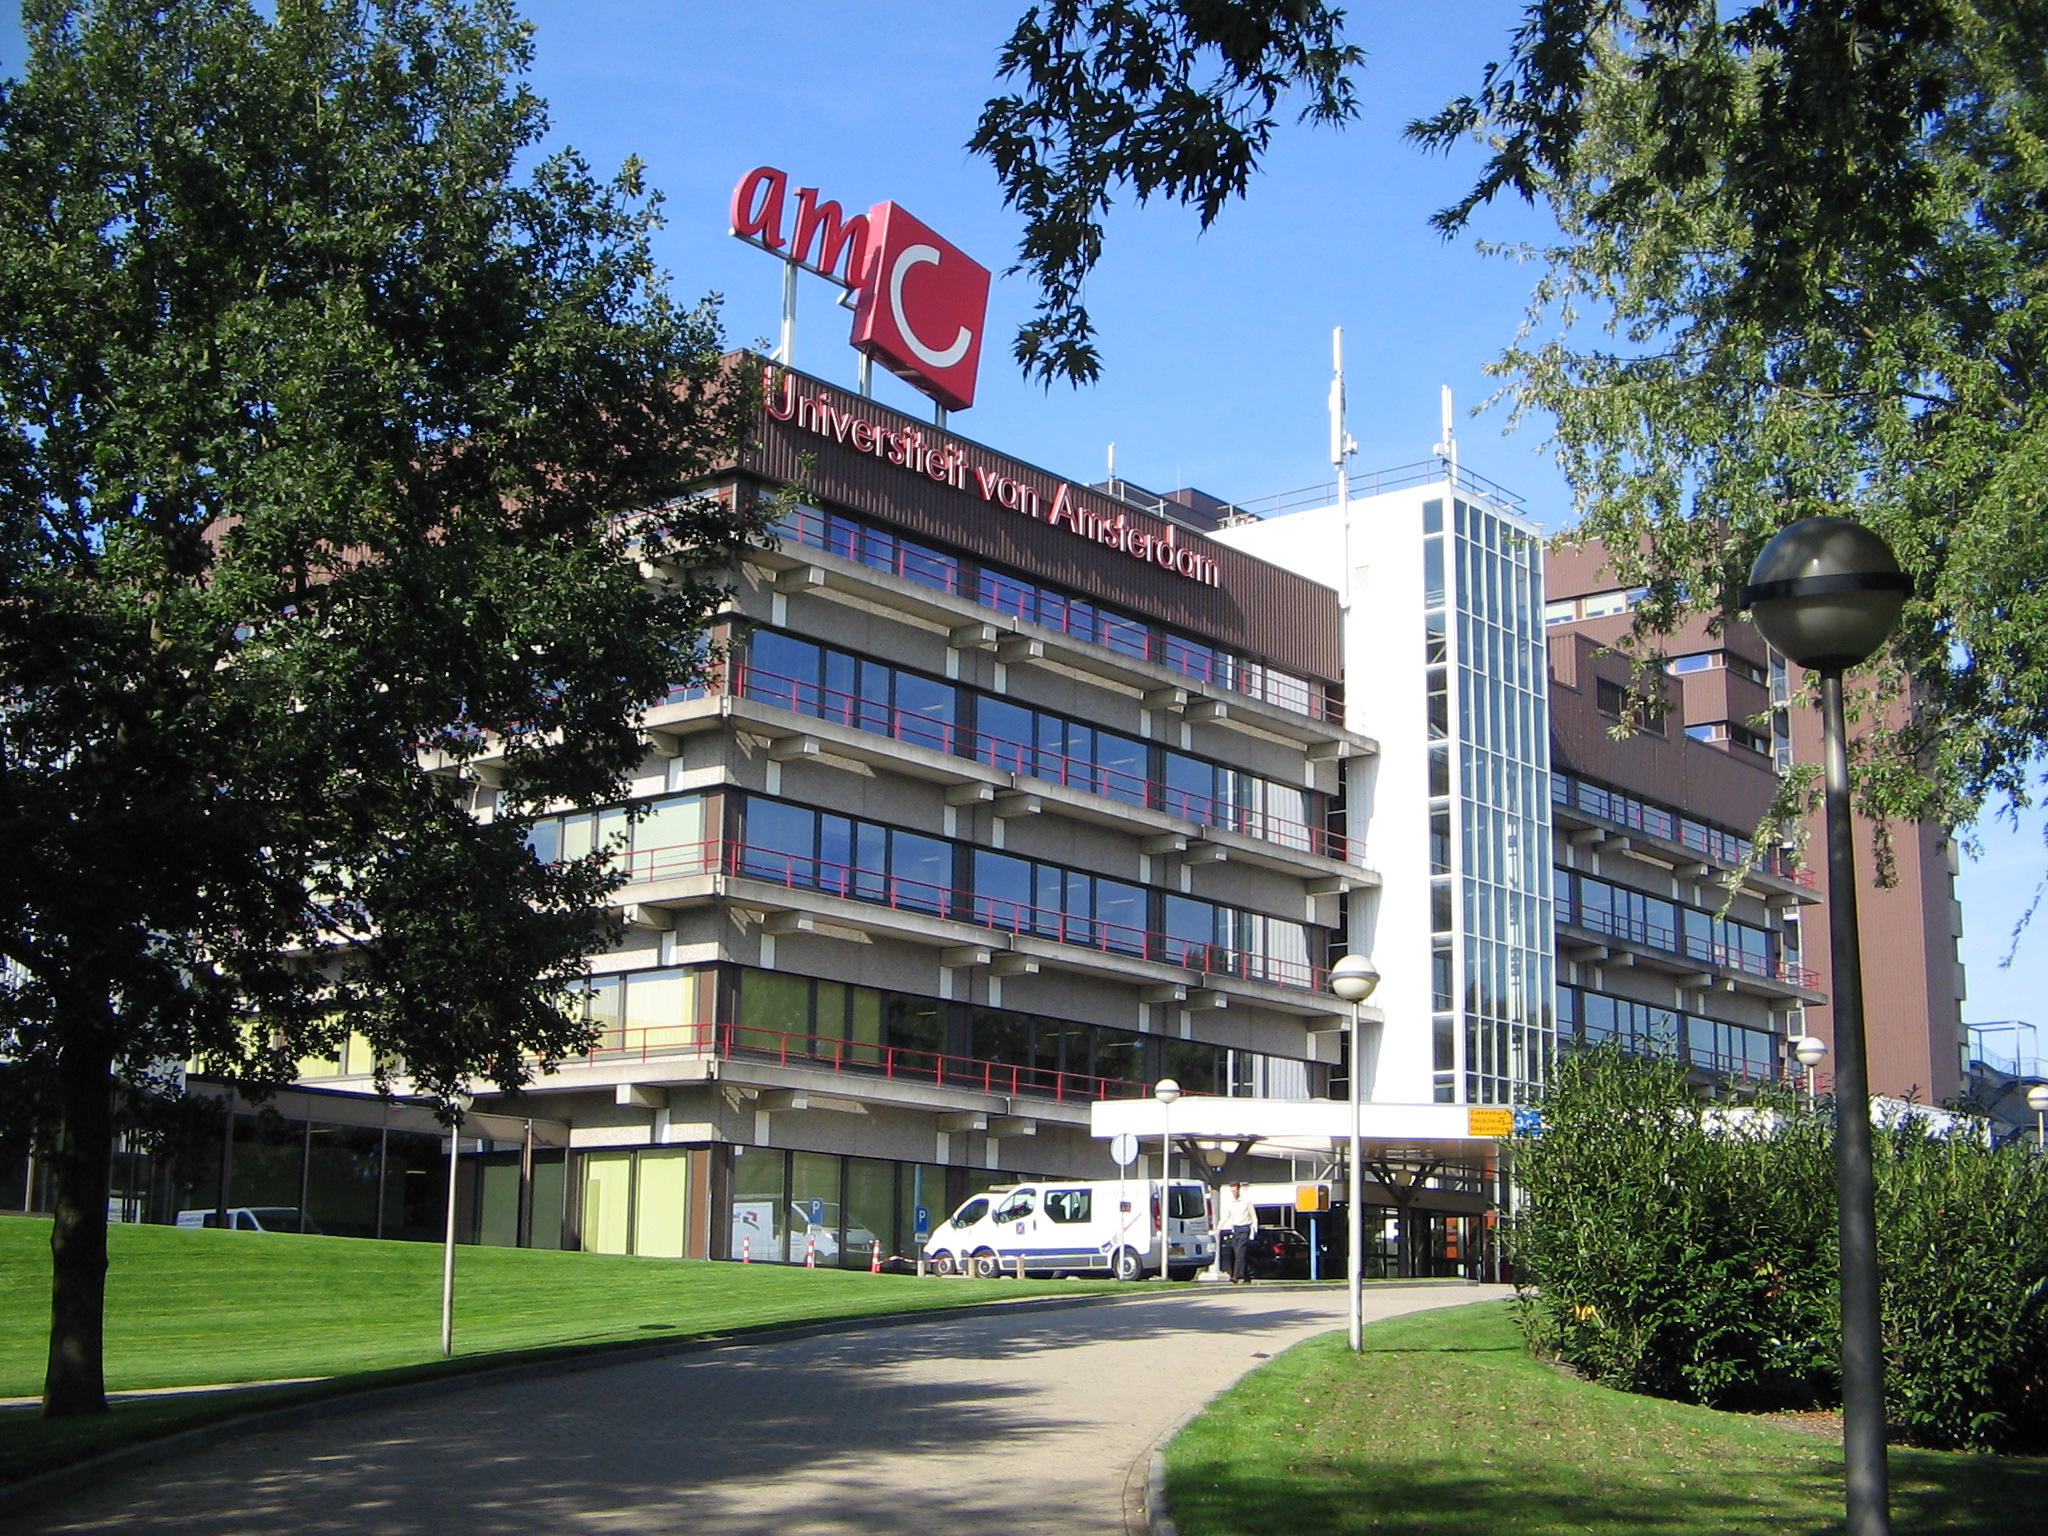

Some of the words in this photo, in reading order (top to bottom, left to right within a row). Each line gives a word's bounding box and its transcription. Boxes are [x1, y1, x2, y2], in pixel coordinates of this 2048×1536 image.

[762, 365, 968, 490] Universiteit
[975, 466, 1040, 518] van
[1048, 482, 1221, 588] Amsterdam
[812, 1200, 820, 1214] P
[919, 1210, 926, 1223] P
